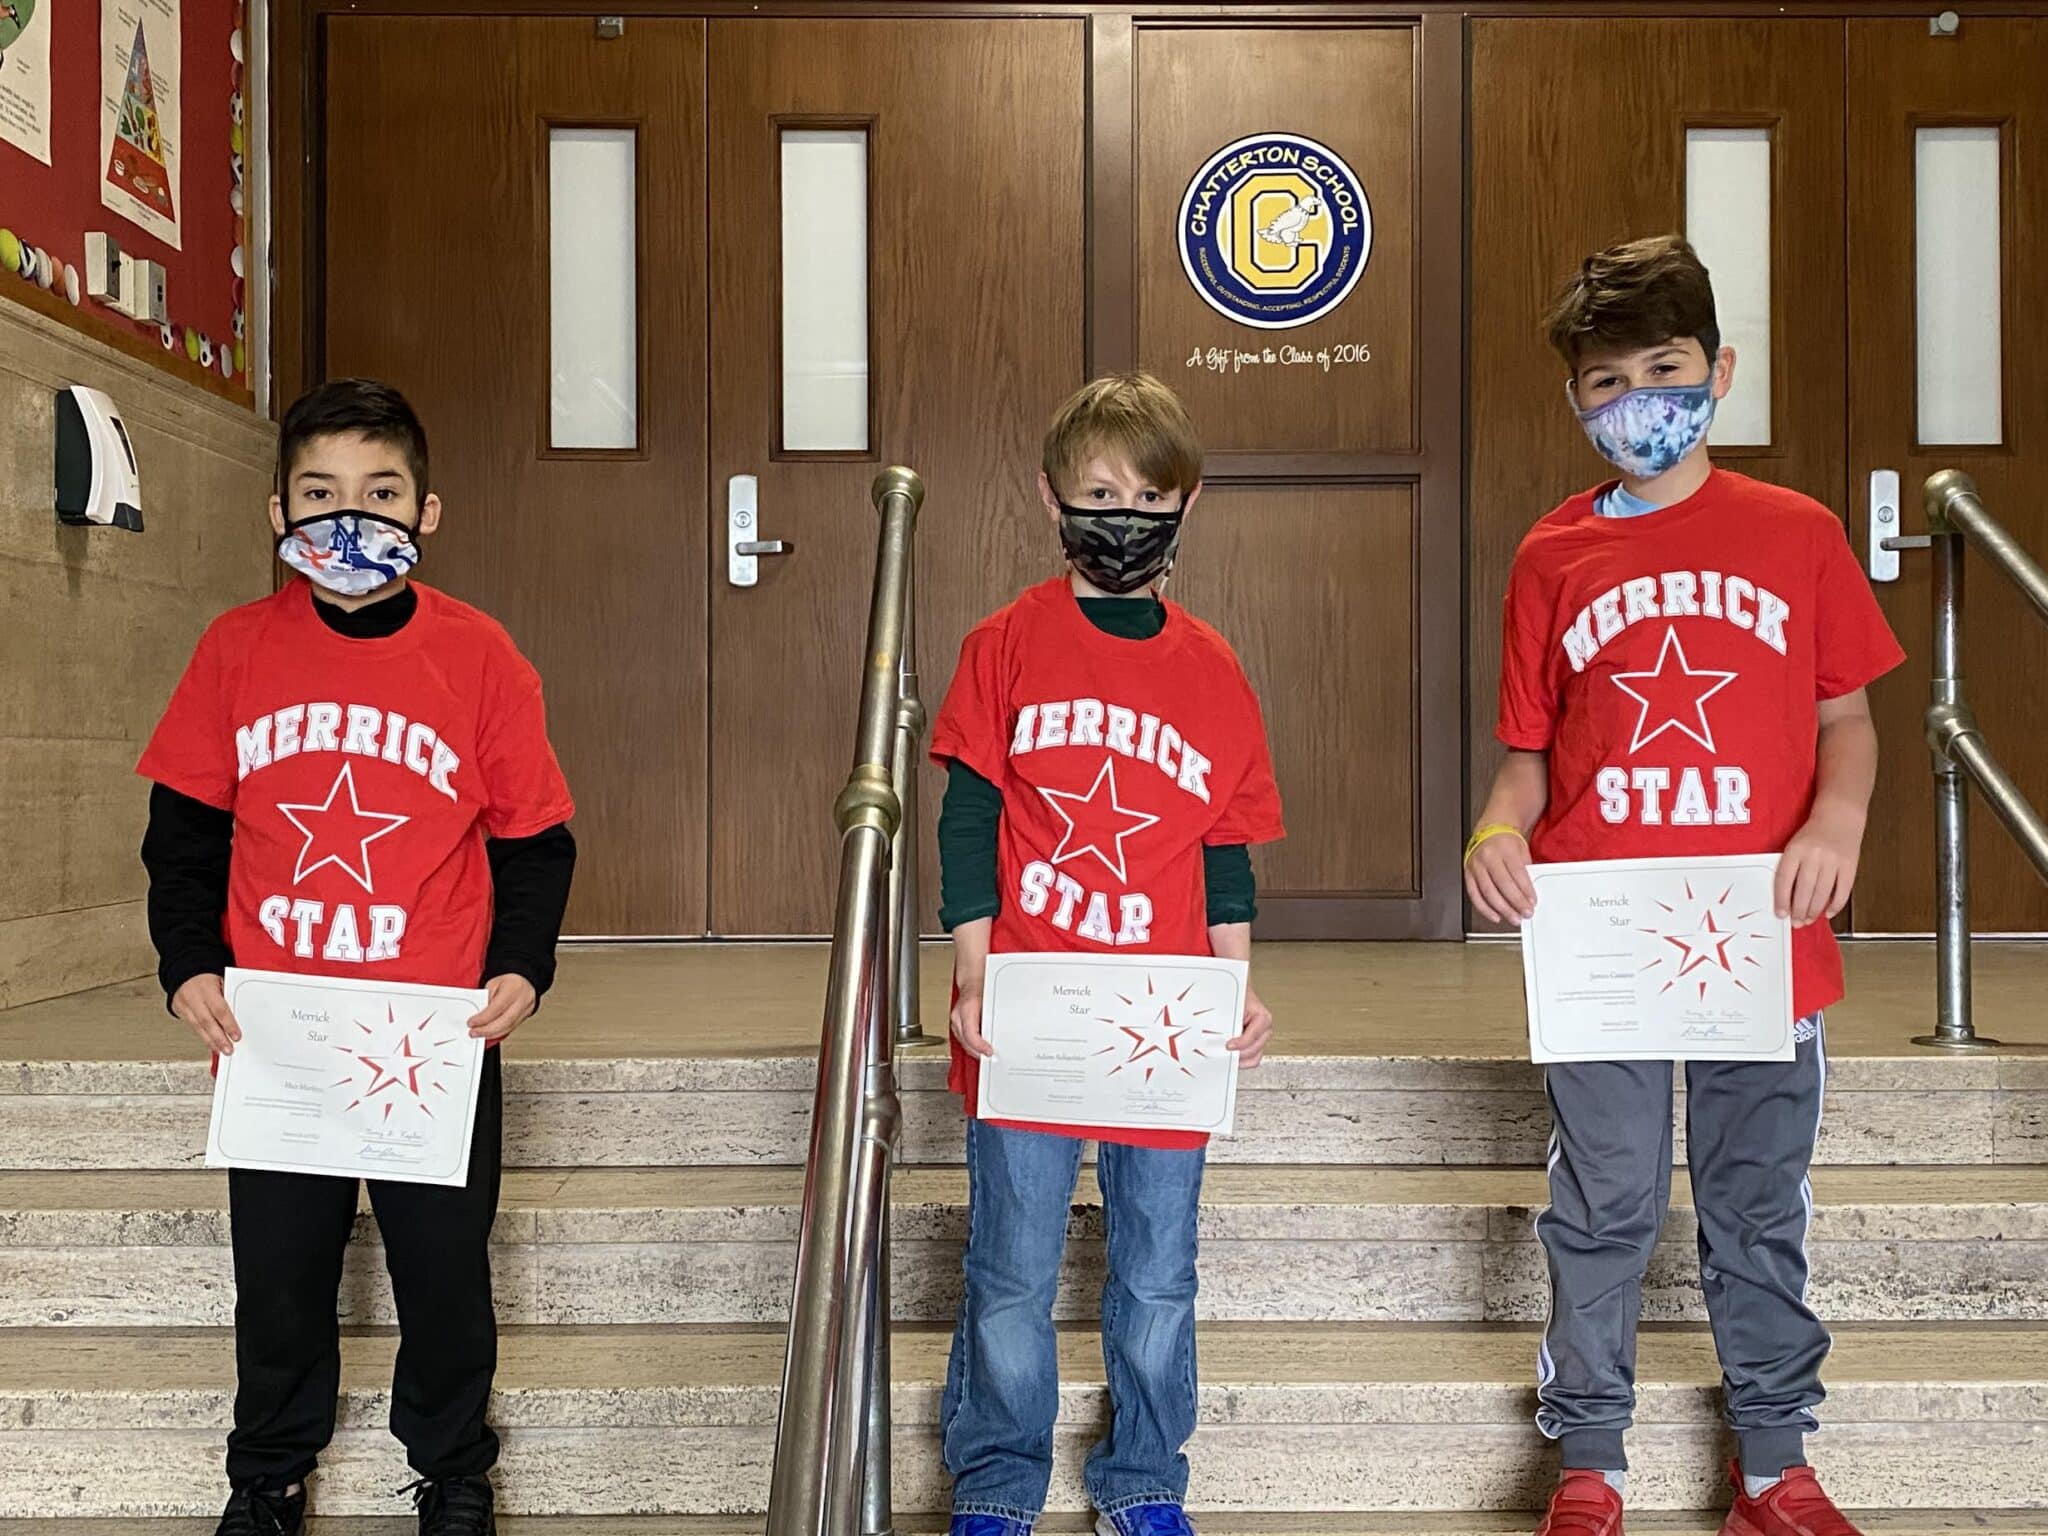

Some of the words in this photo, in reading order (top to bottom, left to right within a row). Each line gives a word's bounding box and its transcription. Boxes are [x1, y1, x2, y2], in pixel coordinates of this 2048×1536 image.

[1191, 146, 1300, 236] CHATTERTON
[1301, 155, 1358, 235] SCHOOL
[1186, 347, 1202, 368] A
[1205, 347, 1232, 374] Gift
[1233, 348, 1260, 374] from
[1262, 346, 1277, 364] the
[1279, 344, 1313, 366] Class
[1316, 347, 1331, 373] of
[1333, 344, 1371, 364] 2016
[1562, 571, 1790, 673] MERRICK
[235, 702, 460, 803] MERRICK
[1596, 766, 1750, 826] STAR
[1020, 860, 1153, 946] STAR
[1589, 893, 1630, 907] Merrick
[259, 894, 407, 963] STAR
[1609, 915, 1632, 927] Star
[1053, 985, 1092, 997] Merrick
[291, 1009, 330, 1023] Merrick
[1069, 1003, 1091, 1015] Star
[307, 1030, 329, 1042] Star
